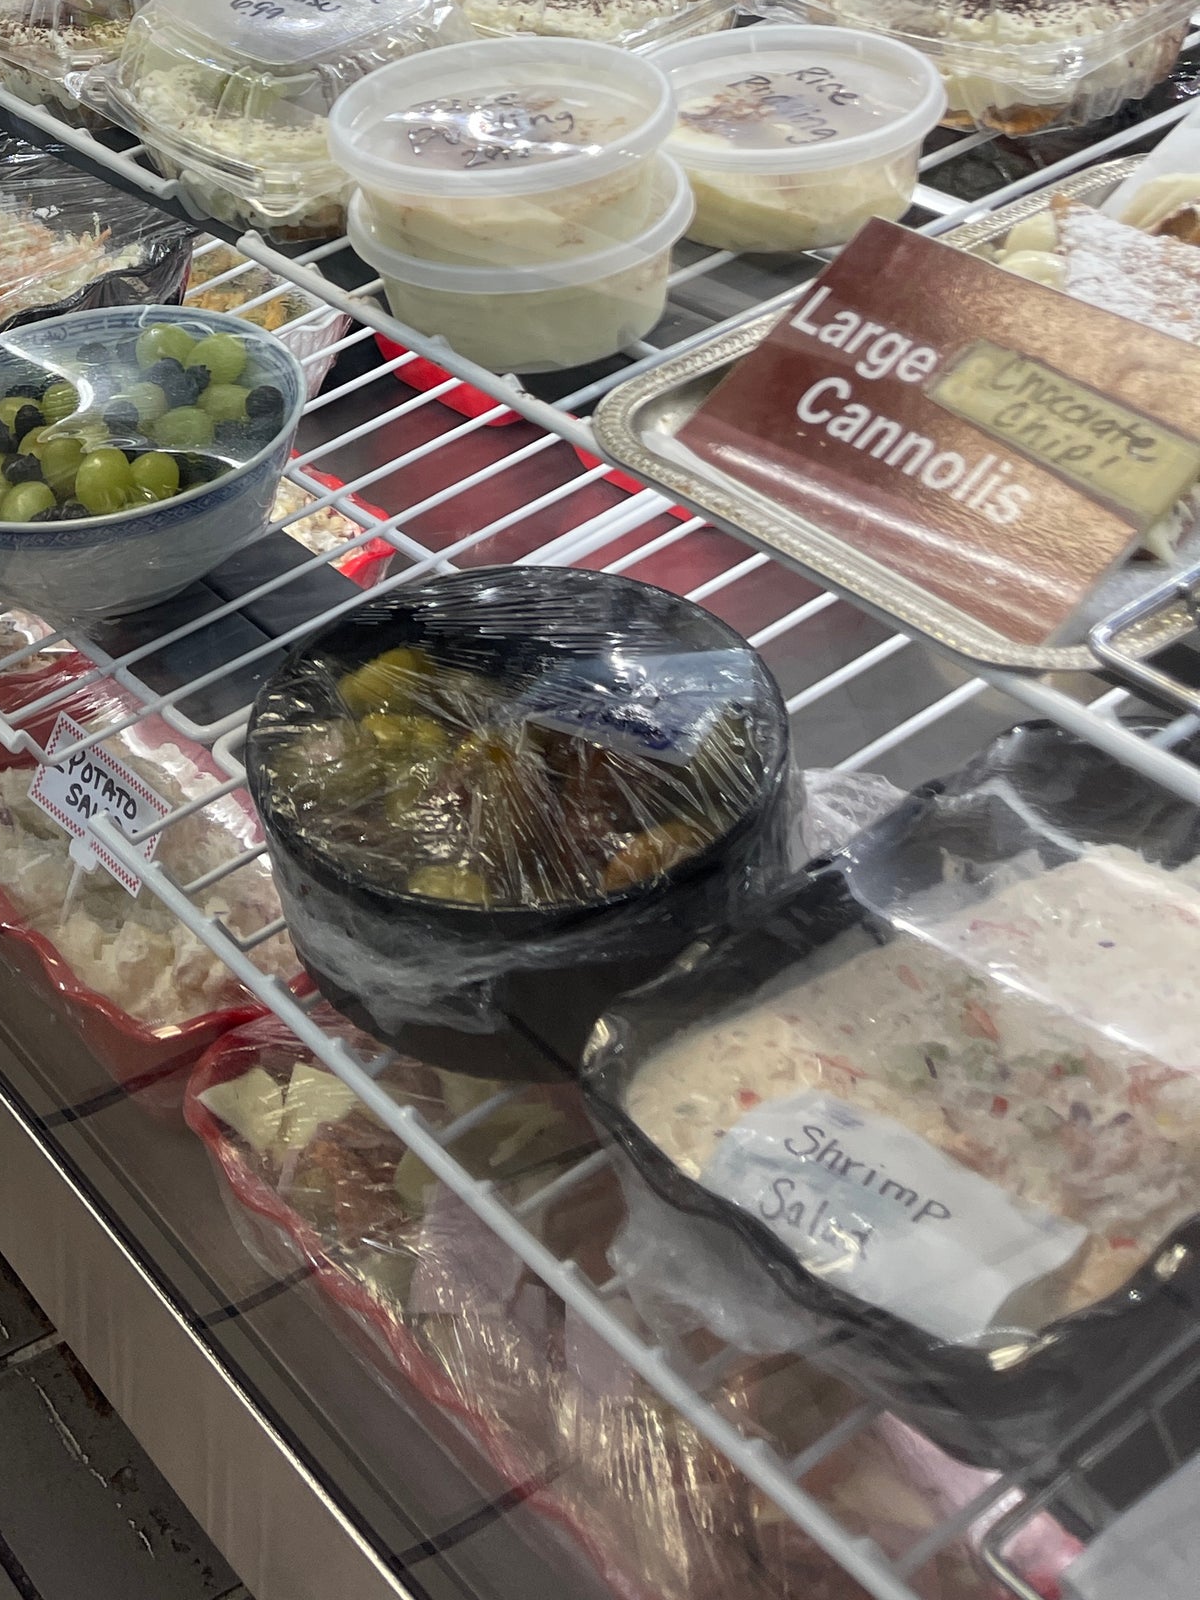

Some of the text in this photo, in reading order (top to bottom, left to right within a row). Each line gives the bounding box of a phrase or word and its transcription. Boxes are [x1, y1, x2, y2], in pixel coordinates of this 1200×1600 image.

[786, 67, 859, 105] Rice
[789, 285, 939, 384] Large
[795, 374, 1032, 528] Cannolis
[986, 352, 1160, 464] Chocolate
[69, 750, 137, 820] POTATO
[783, 1123, 952, 1226] Shrimp
